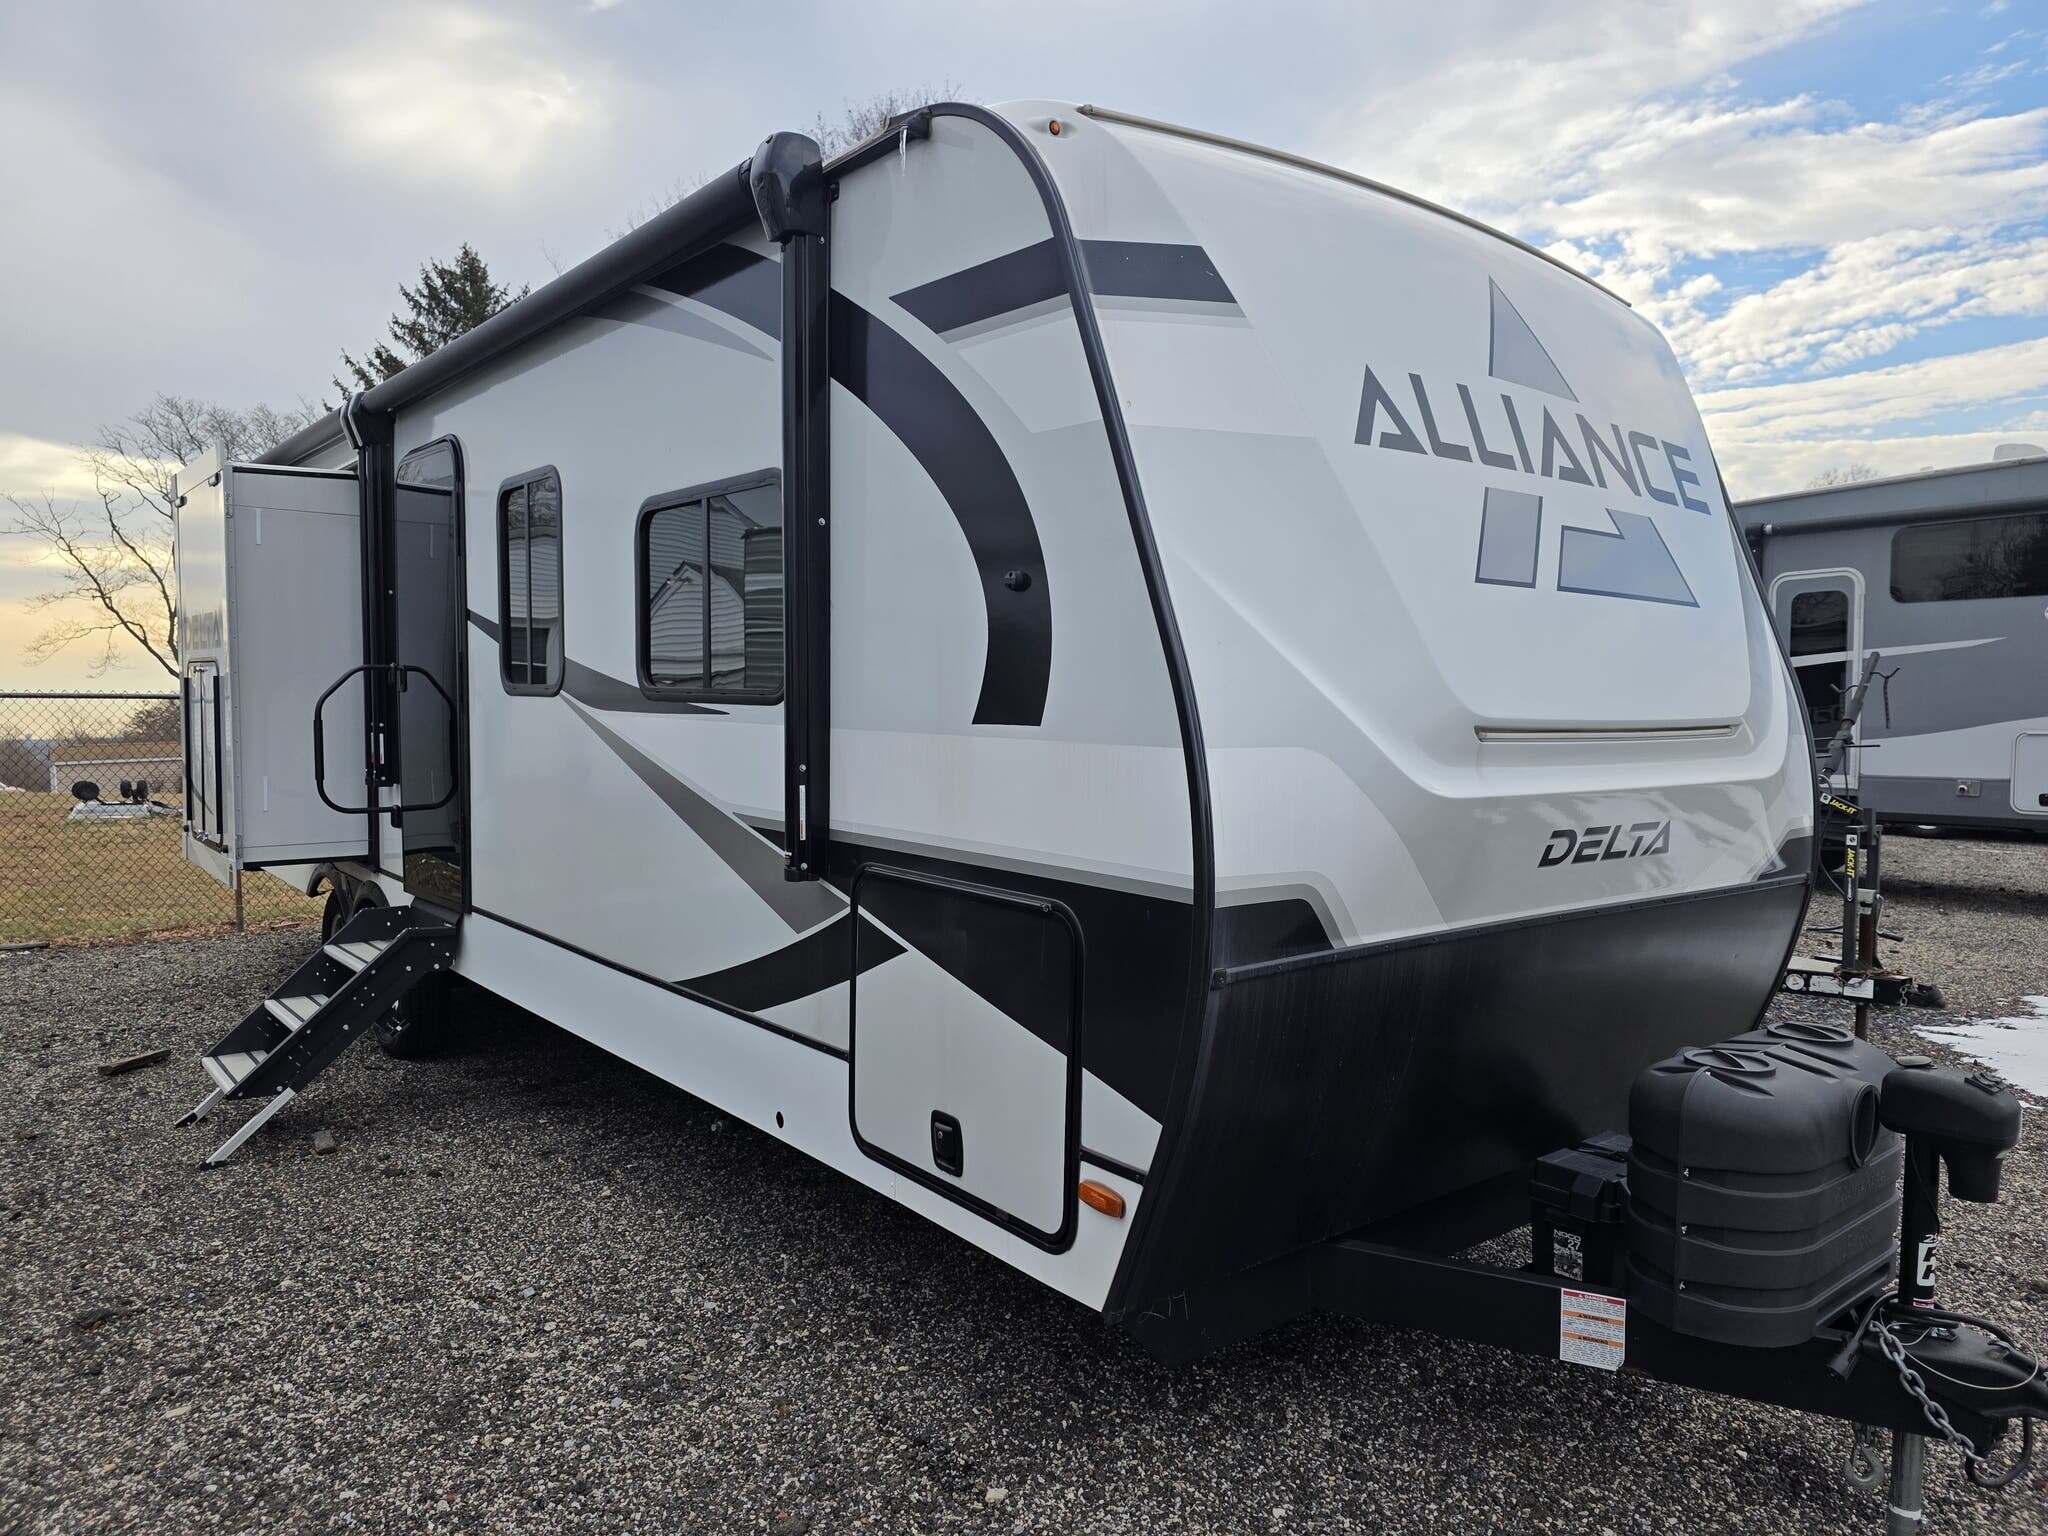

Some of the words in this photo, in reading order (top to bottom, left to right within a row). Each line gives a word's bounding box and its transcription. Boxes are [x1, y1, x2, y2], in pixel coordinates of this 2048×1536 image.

[1354, 363, 1713, 516] ALLIANCE
[1829, 799, 1858, 815] JACK-IT
[1537, 820, 1671, 868] DELTA
[1846, 848, 1856, 879] JACK-IT
